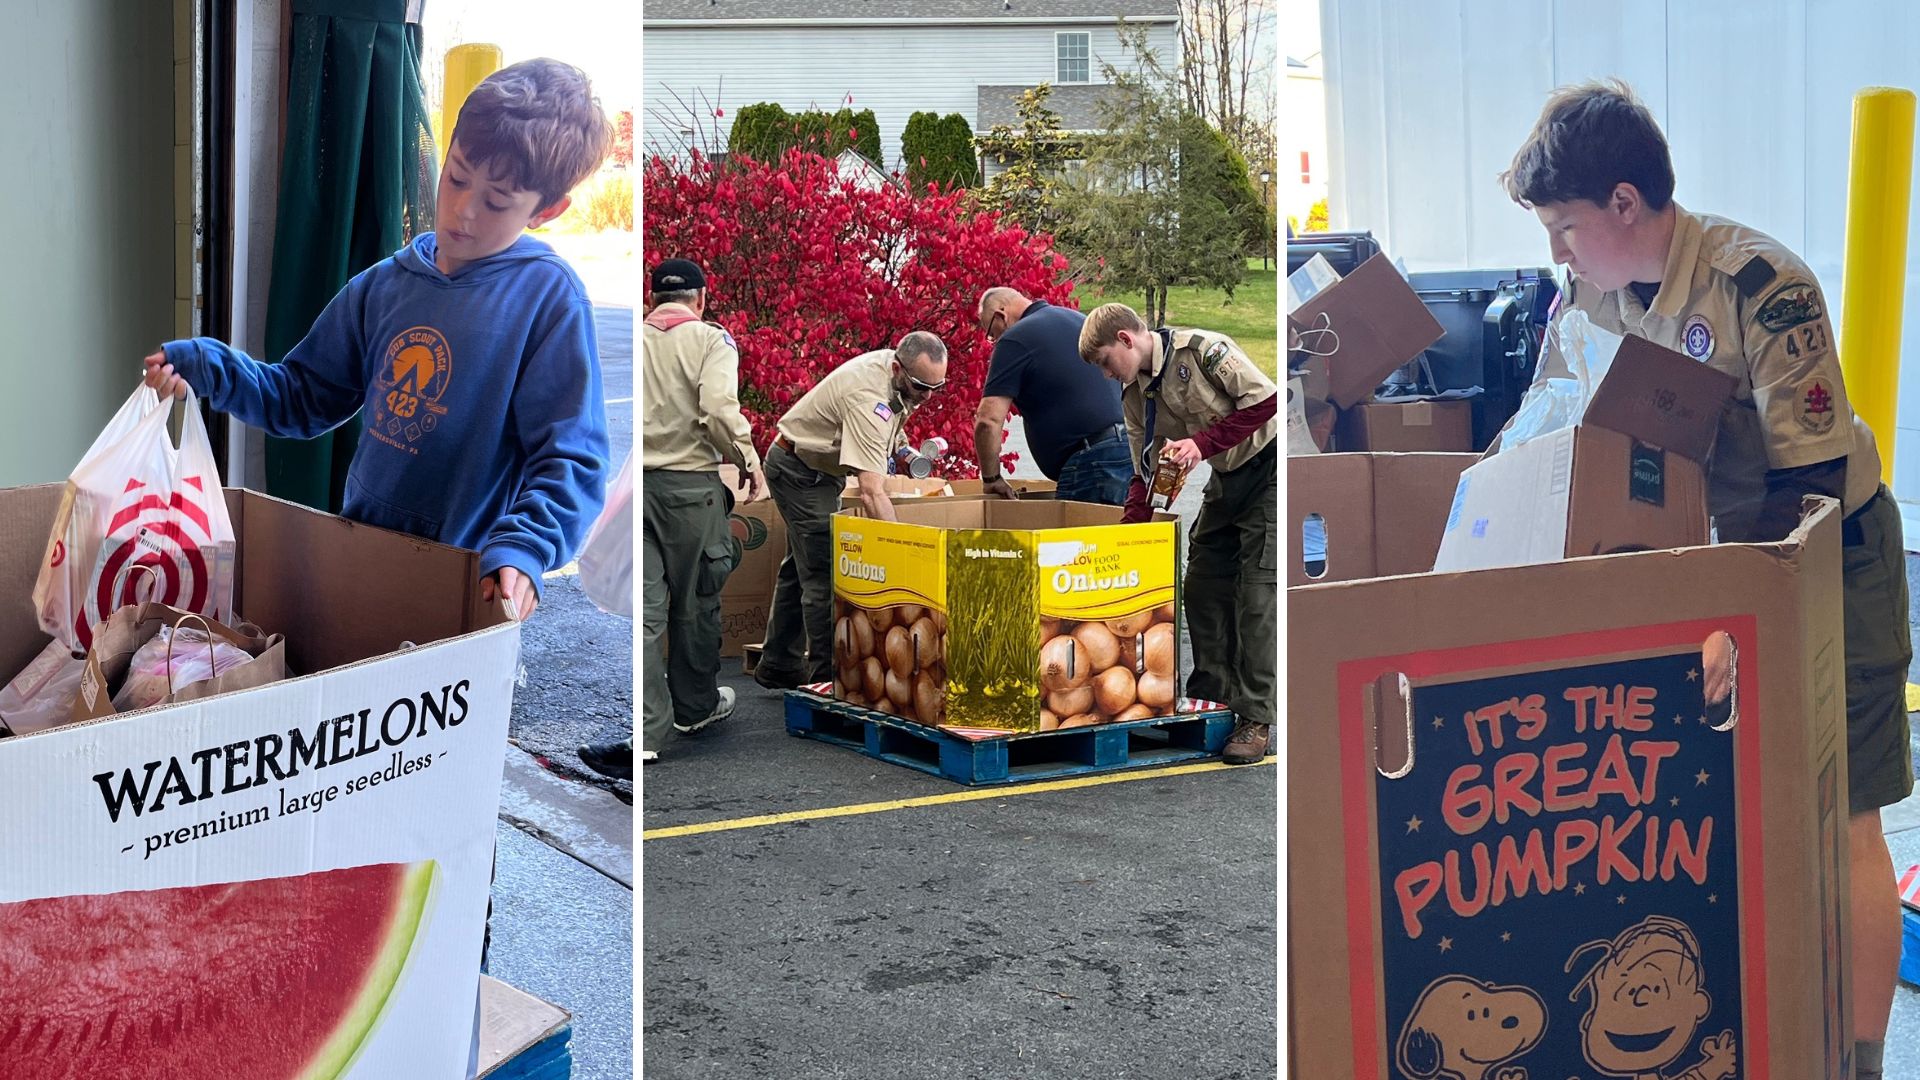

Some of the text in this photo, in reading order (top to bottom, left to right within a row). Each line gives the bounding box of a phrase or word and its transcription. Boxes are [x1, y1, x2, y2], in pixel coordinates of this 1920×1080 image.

[390, 332, 447, 371] CUB SCOUT PACK
[386, 390, 419, 418] 423
[840, 542, 863, 554] YELLOW
[965, 548, 1023, 560] High in Vitamin C
[1094, 553, 1120, 565] FOOD
[839, 554, 887, 583] Onions
[1052, 569, 1139, 593] Onions
[1095, 564, 1120, 574] BANK
[1463, 684, 1658, 756] IT'S THE
[92, 679, 470, 823] WATERMELONS
[1441, 733, 1680, 835] GREAT
[143, 752, 432, 860] premium large seedless
[1394, 810, 1714, 939] PUMPKIN
